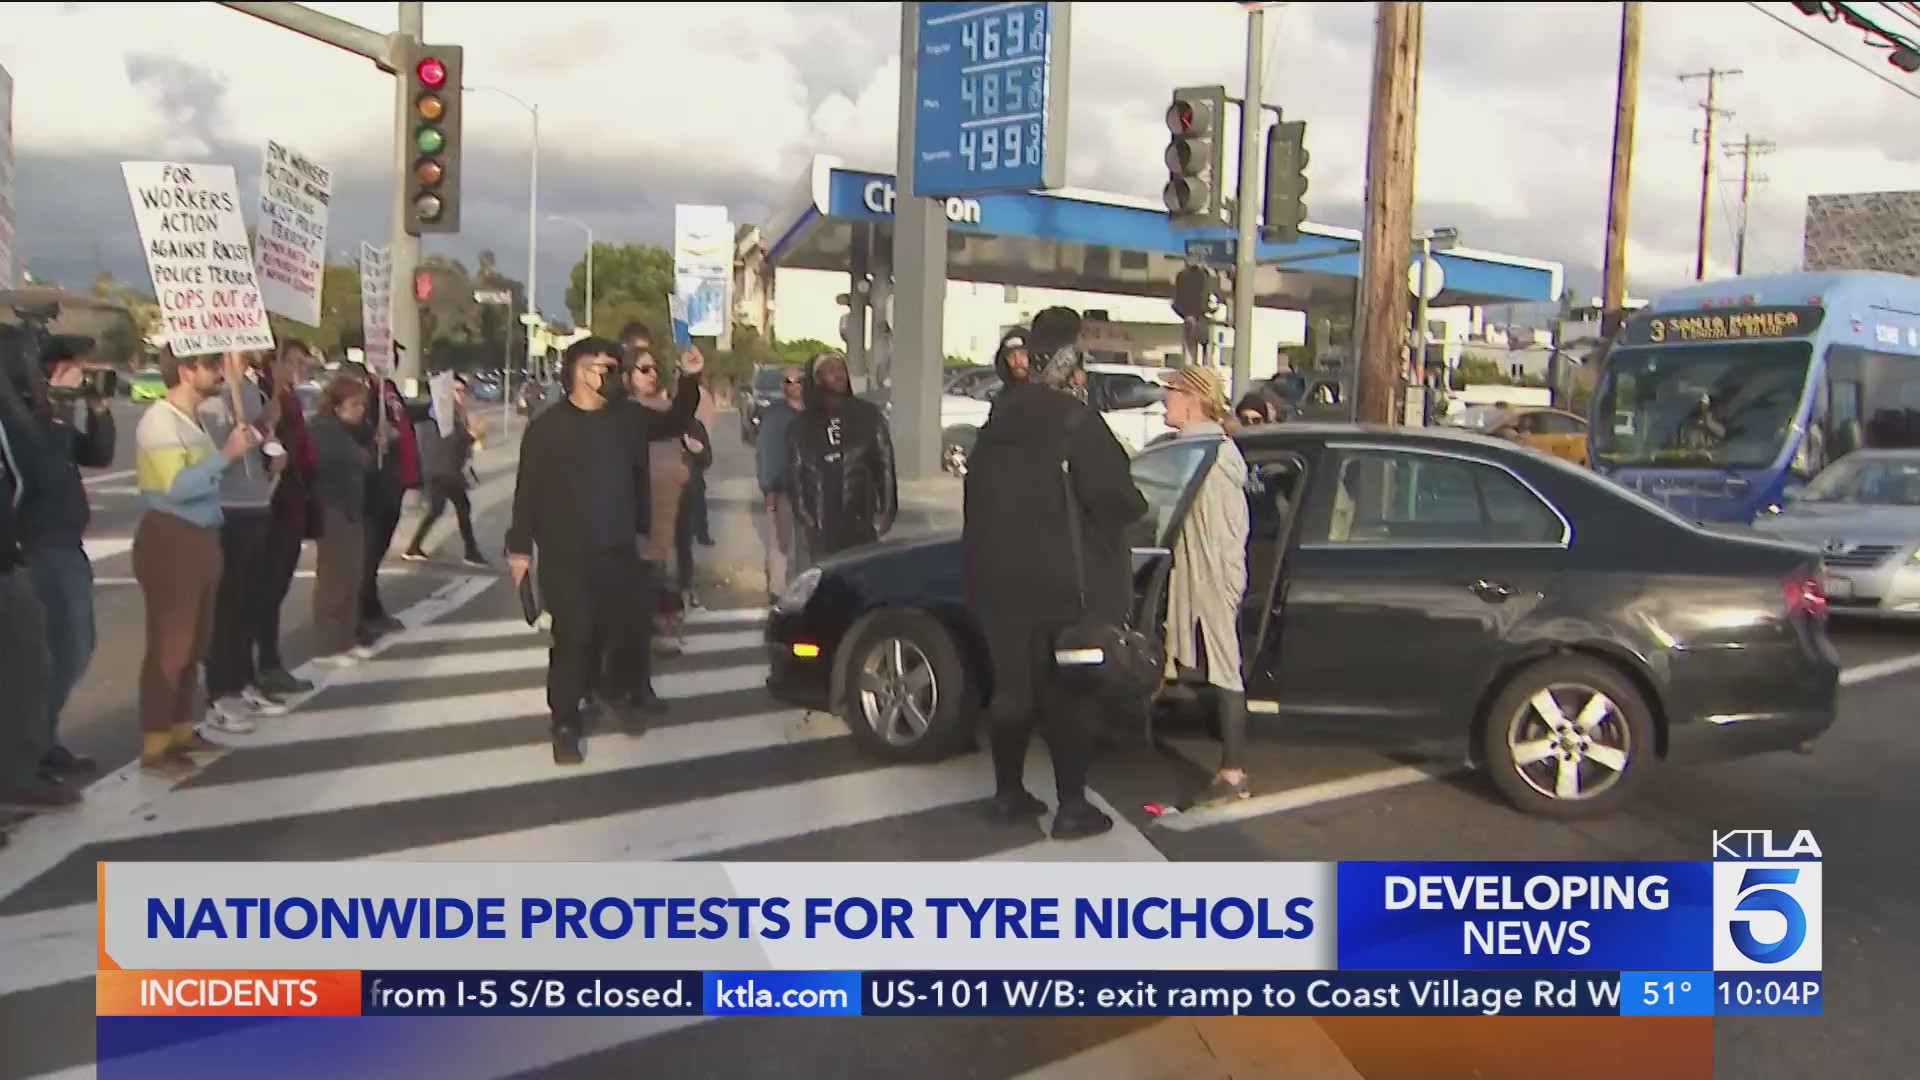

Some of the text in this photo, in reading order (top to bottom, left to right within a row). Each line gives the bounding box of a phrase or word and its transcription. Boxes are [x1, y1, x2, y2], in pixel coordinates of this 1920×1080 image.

[961, 12, 1025, 62] 469
[961, 68, 1022, 116] 485
[959, 125, 1022, 171] 499
[163, 165, 195, 184] FOR
[139, 187, 233, 212] WORKERS
[864, 180, 980, 224] Chon
[160, 212, 218, 234] ACTION
[150, 239, 206, 259] AGAINST
[154, 264, 203, 283] POLICE
[207, 265, 256, 288] TERROR
[164, 289, 258, 311] COPS OUT OF
[168, 310, 262, 332] THE UNIONS!
[1650, 319, 1665, 342] 3
